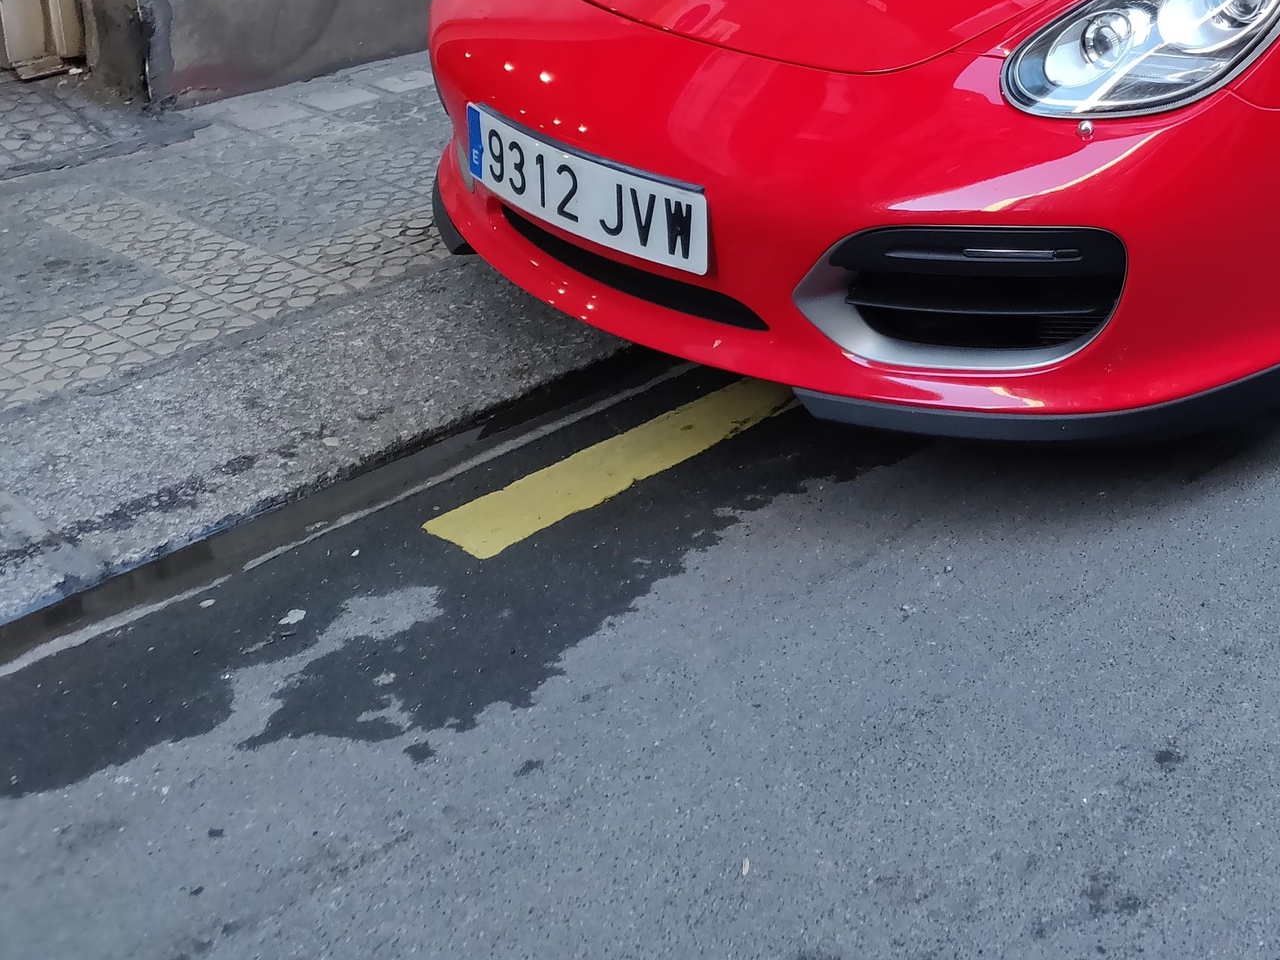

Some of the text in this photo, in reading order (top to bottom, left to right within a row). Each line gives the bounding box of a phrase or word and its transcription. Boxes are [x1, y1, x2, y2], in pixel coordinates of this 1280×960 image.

[472, 149, 480, 166] E
[487, 128, 693, 260] 9312 JVW
